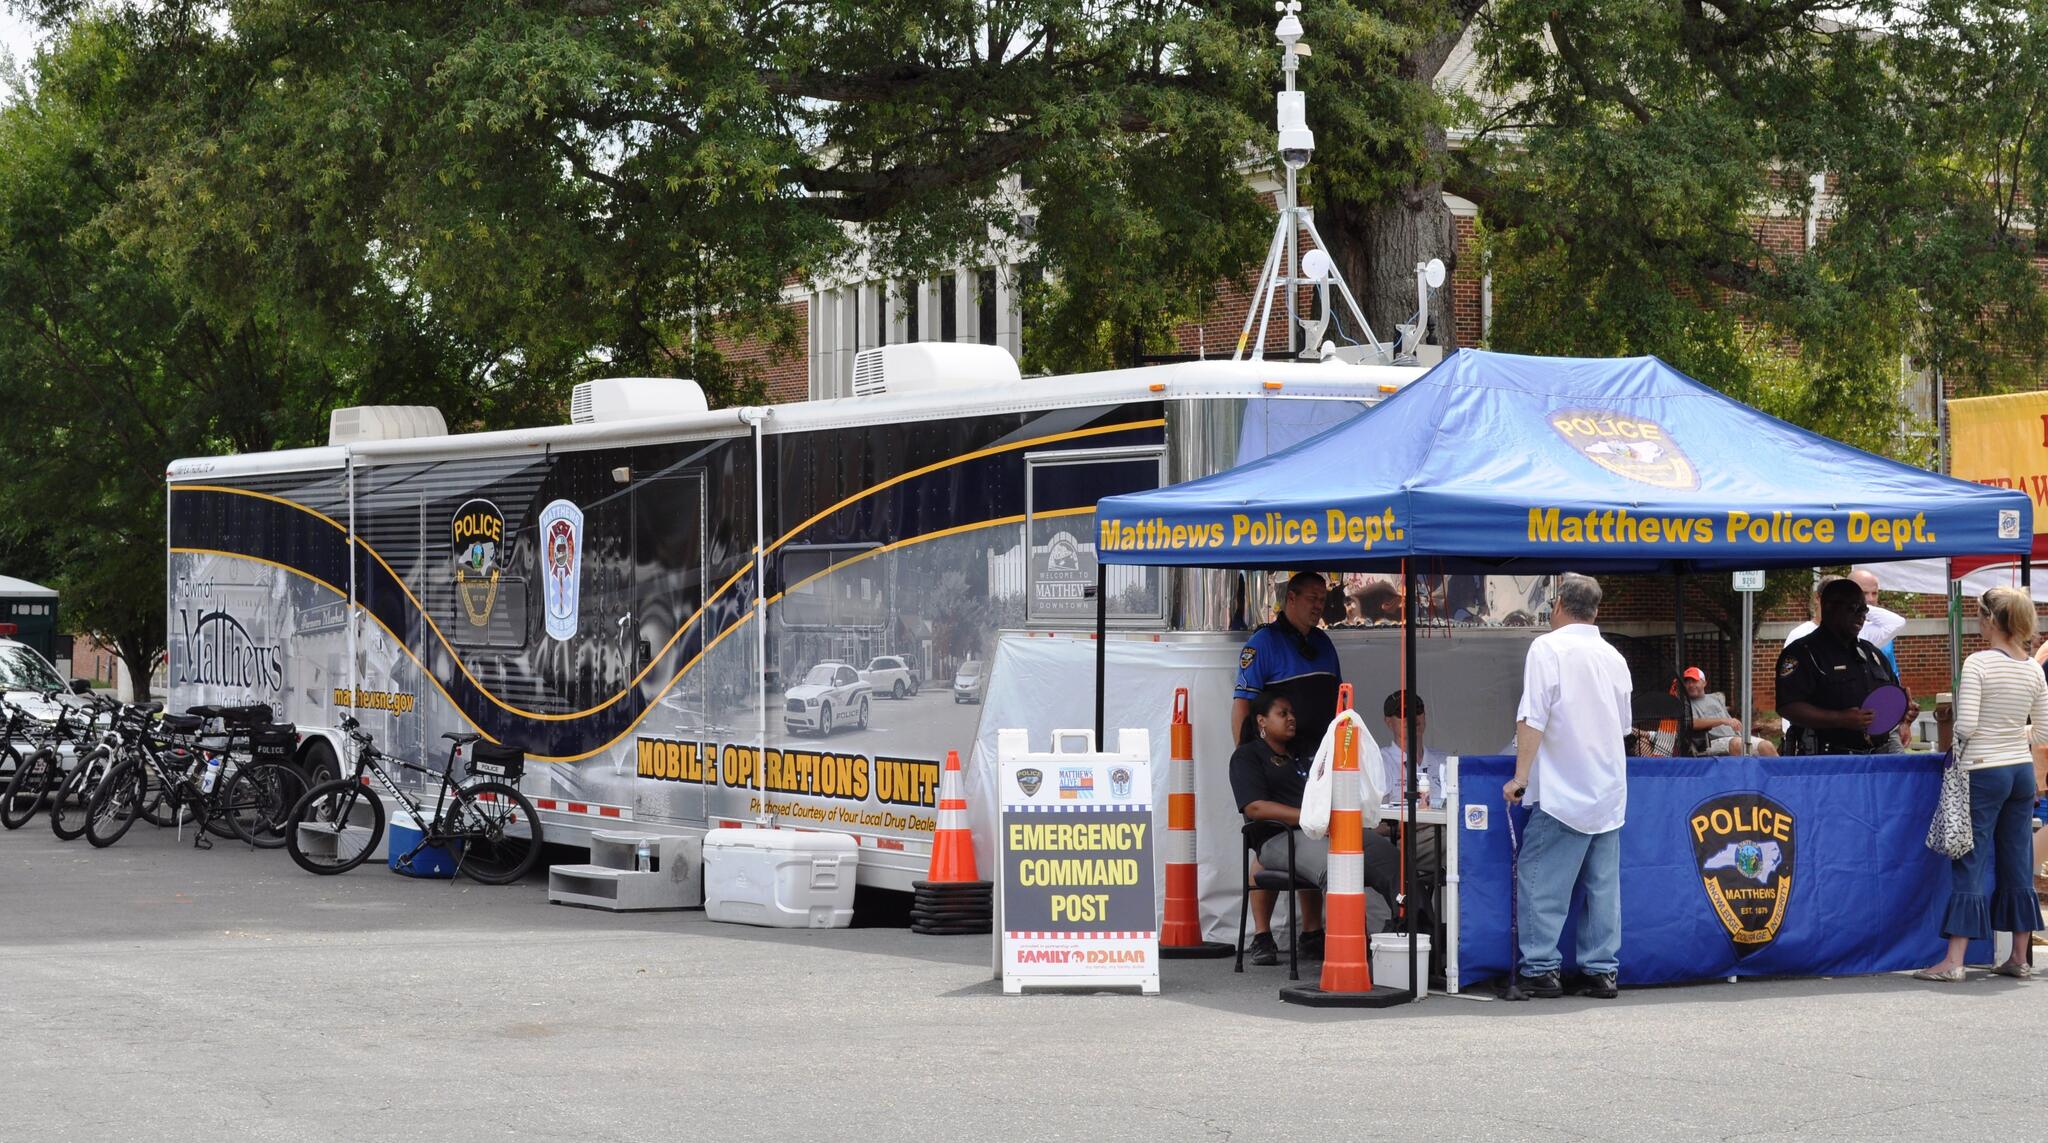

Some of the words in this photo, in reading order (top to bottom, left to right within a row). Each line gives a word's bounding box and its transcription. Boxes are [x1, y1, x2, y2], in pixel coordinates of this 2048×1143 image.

[1553, 418, 1661, 440] POLICE
[454, 513, 501, 543] POLICE
[1101, 517, 1224, 551] Matthews
[1232, 512, 1317, 546] Police
[1326, 506, 1404, 551] Dept.
[1528, 507, 1713, 544] Matthews
[1727, 510, 1834, 544] Police
[1847, 511, 1936, 551] Dept.
[180, 577, 203, 598] Town
[204, 576, 214, 598] of
[1040, 571, 1073, 580] WELCOME
[1079, 571, 1089, 579] TO
[1035, 583, 1086, 597] MATTHEW
[1039, 601, 1089, 609] DOWNTOWN
[180, 594, 283, 692] Matthews
[481, 763, 499, 773] POLICE
[637, 737, 717, 784] MOBILE
[874, 756, 940, 807] UNIT
[1059, 770, 1094, 779] MATTHEWS
[1059, 778, 1077, 786] ALIVE
[792, 803, 826, 822] Courtesy
[828, 806, 838, 820] of
[838, 808, 859, 823] Your
[859, 812, 883, 826] Local
[884, 813, 906, 829] Drug
[1691, 806, 1793, 843] POLICE
[1009, 823, 1146, 850] EMERGENCY
[1019, 859, 1139, 886] COMMAND
[1707, 880, 1739, 933] KNOWLEDGE
[1725, 888, 1776, 900] MATTHEWS
[1051, 894, 1109, 922] POST
[1770, 882, 1790, 933] INTEGRITY
[1017, 950, 1071, 964] FAMILY
[1086, 950, 1145, 964] DOLLAR
